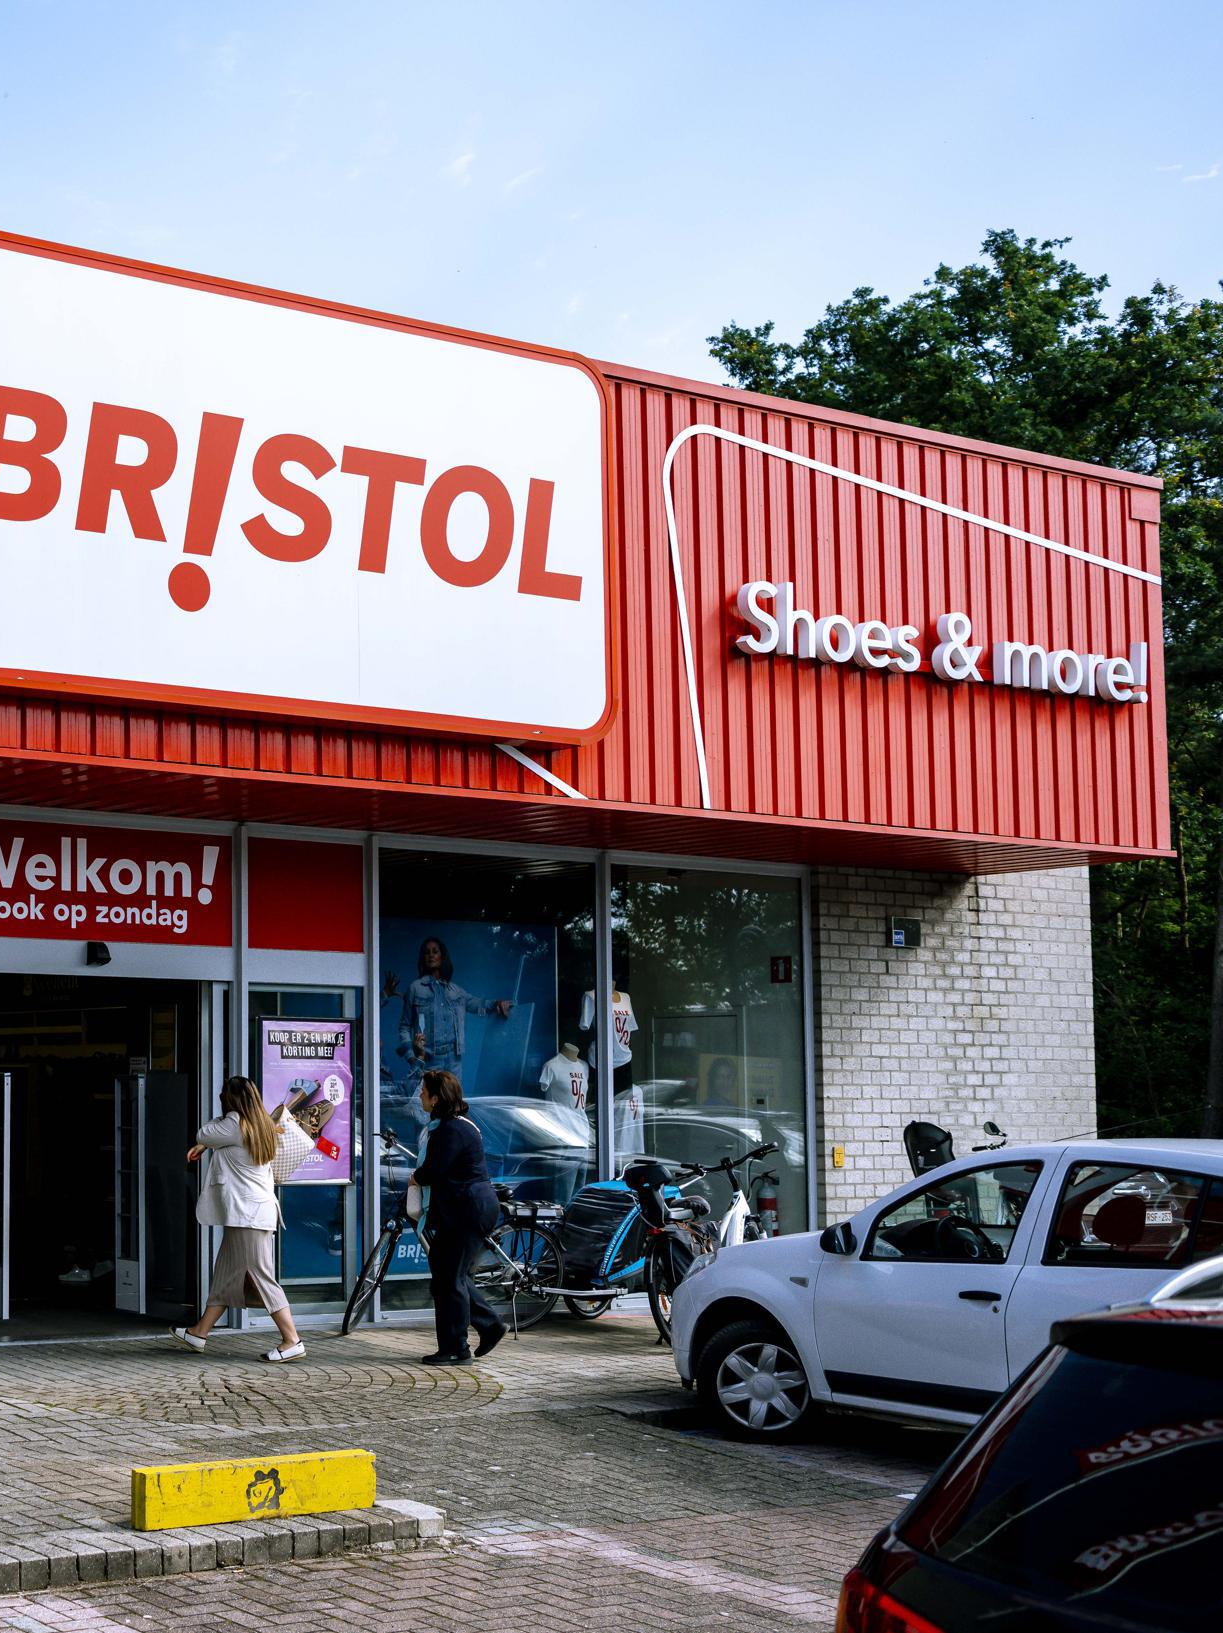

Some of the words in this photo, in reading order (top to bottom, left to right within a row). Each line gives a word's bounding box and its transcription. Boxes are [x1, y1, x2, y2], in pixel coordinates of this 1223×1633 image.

[735, 580, 921, 673] Shoes
[932, 611, 983, 682] &
[993, 640, 1148, 704] more!
[53, 903, 87, 928] op
[95, 900, 188, 933] zondag
[269, 1031, 289, 1043] KOOP
[291, 1032, 302, 1043] ER
[303, 1033, 309, 1043] 2
[310, 1033, 321, 1044] EN
[322, 1033, 336, 1044] PAK
[336, 1033, 344, 1045] JE
[283, 1045, 316, 1057] KORTING
[317, 1046, 333, 1057] MEE!
